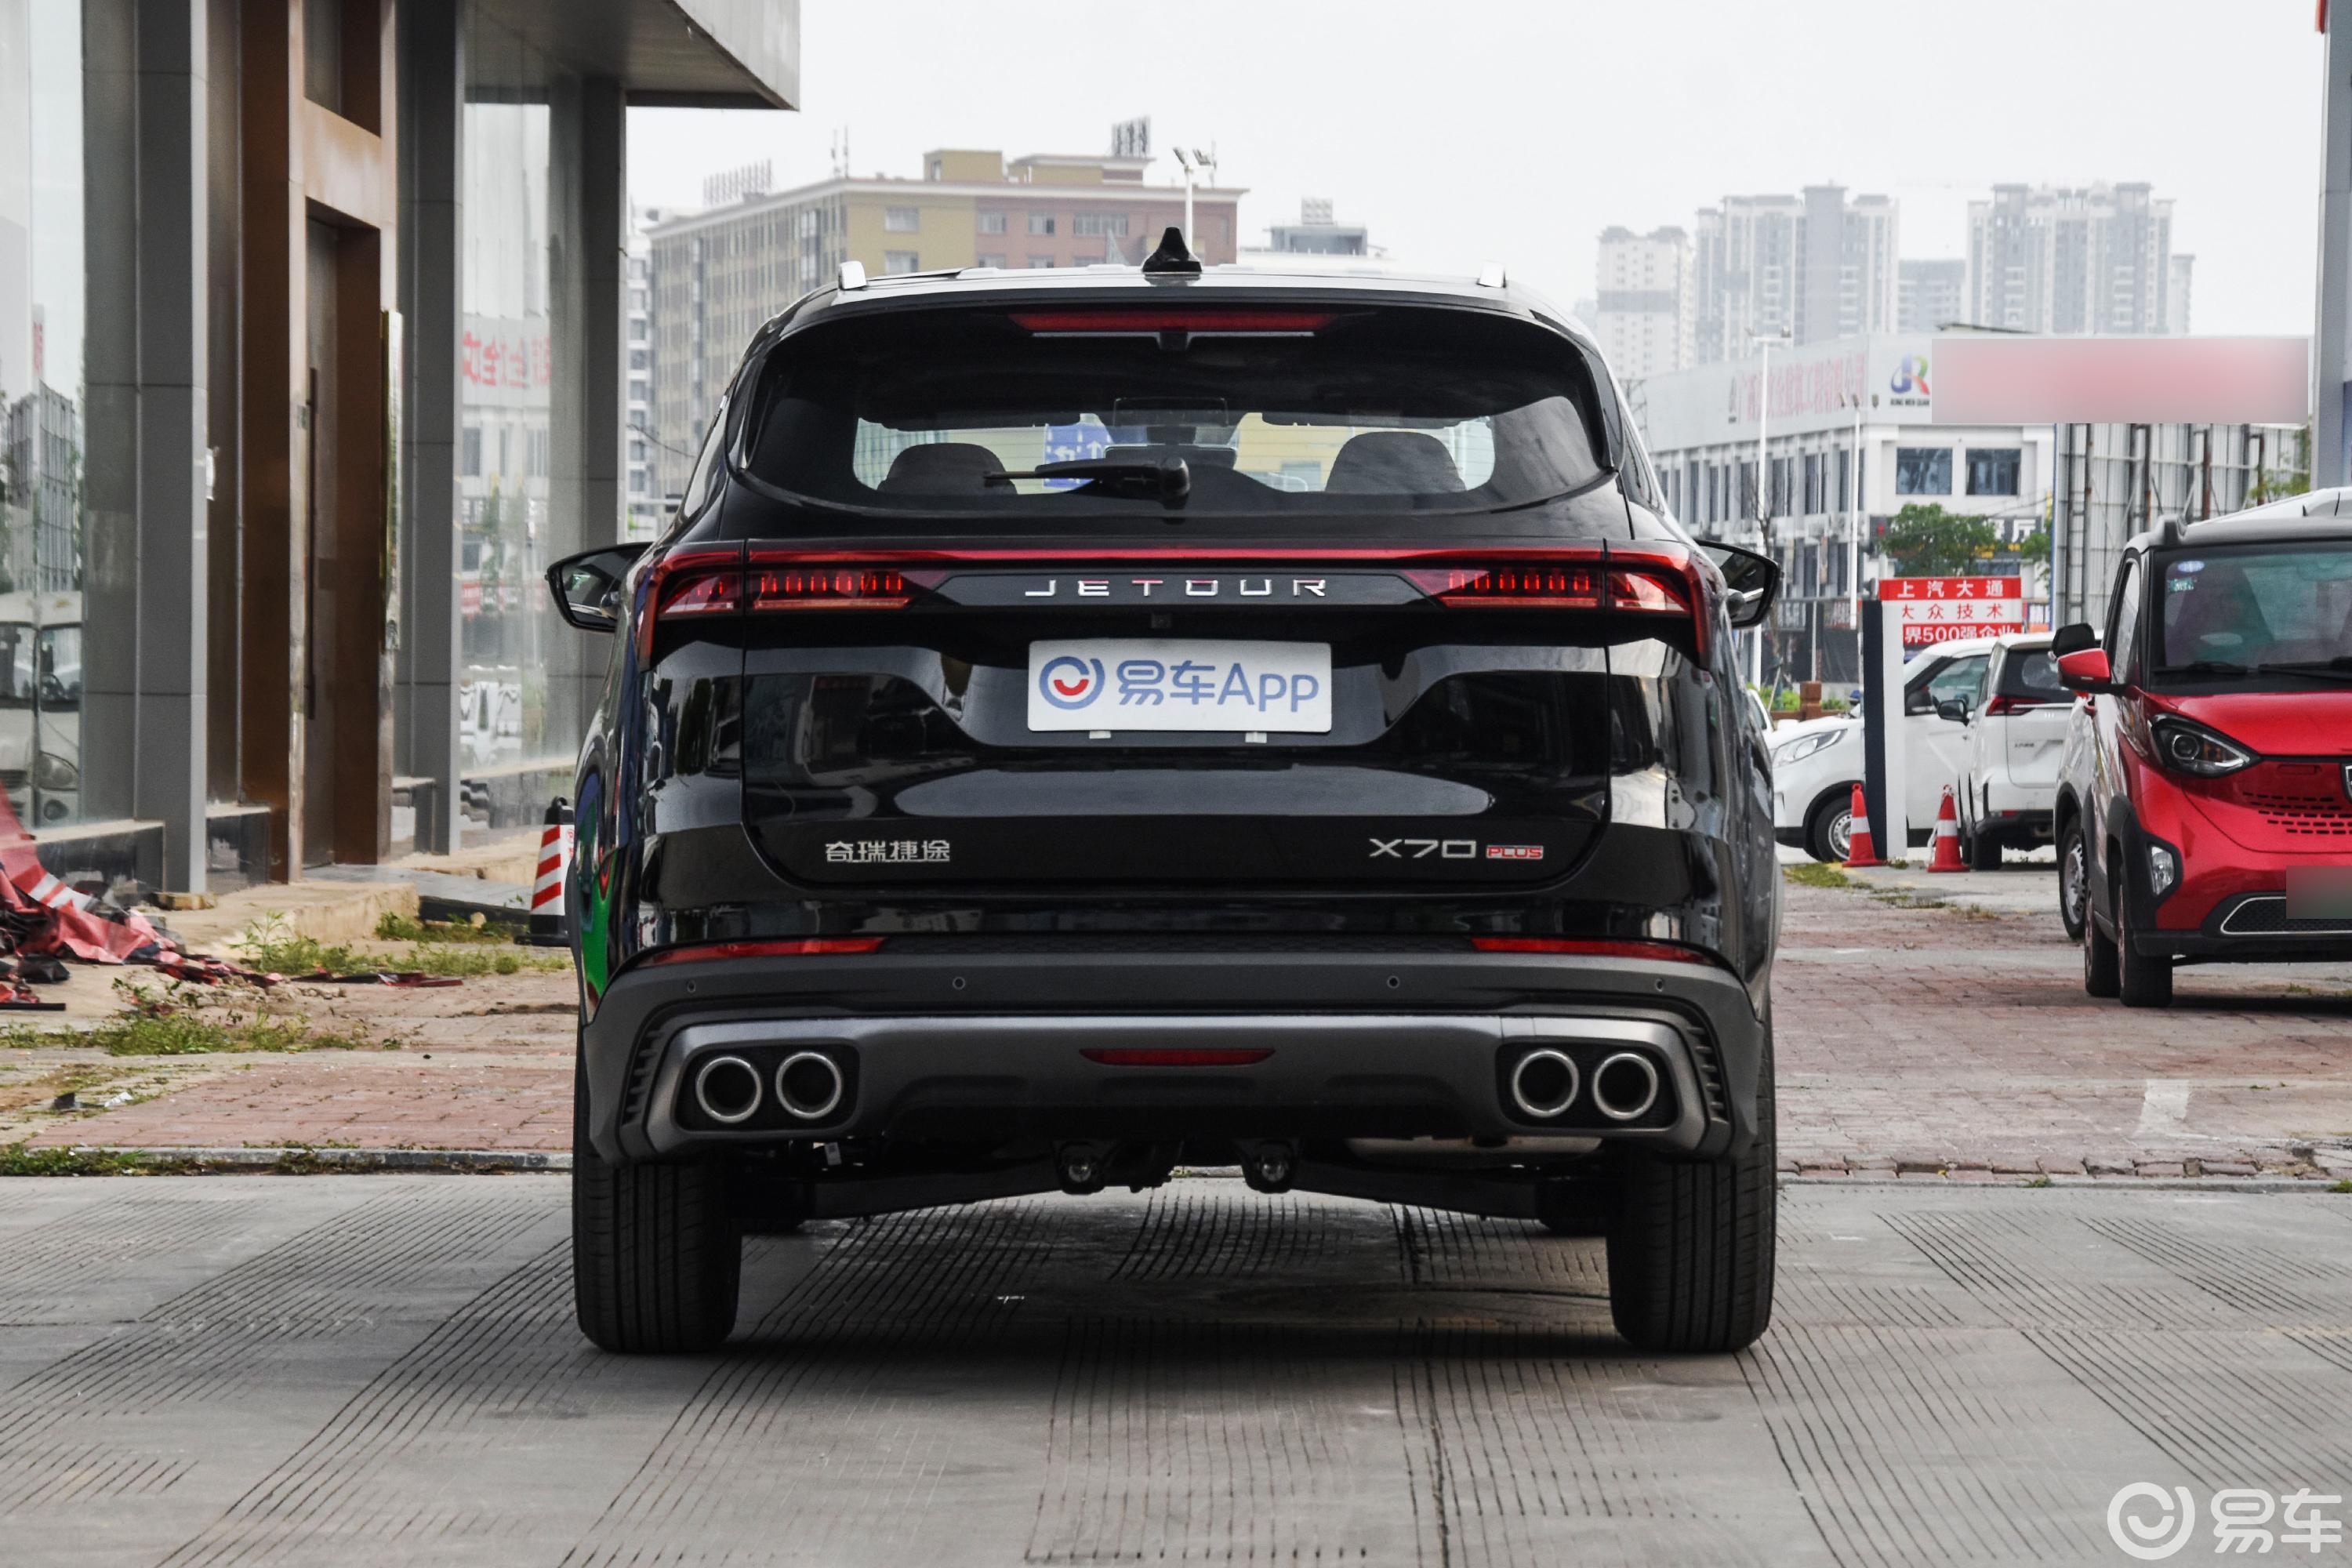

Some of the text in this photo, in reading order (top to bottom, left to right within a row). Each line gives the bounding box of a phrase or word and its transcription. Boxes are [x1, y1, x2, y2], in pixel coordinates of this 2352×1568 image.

[1025, 579, 1327, 597] JETOUR
[1897, 579, 2004, 598] 上汽大通
[1902, 603, 2003, 620] 大众技术
[1116, 659, 1319, 712] 易车App
[826, 840, 950, 862] 奇瑞捷途
[1369, 838, 1544, 859] X70 PLUS
